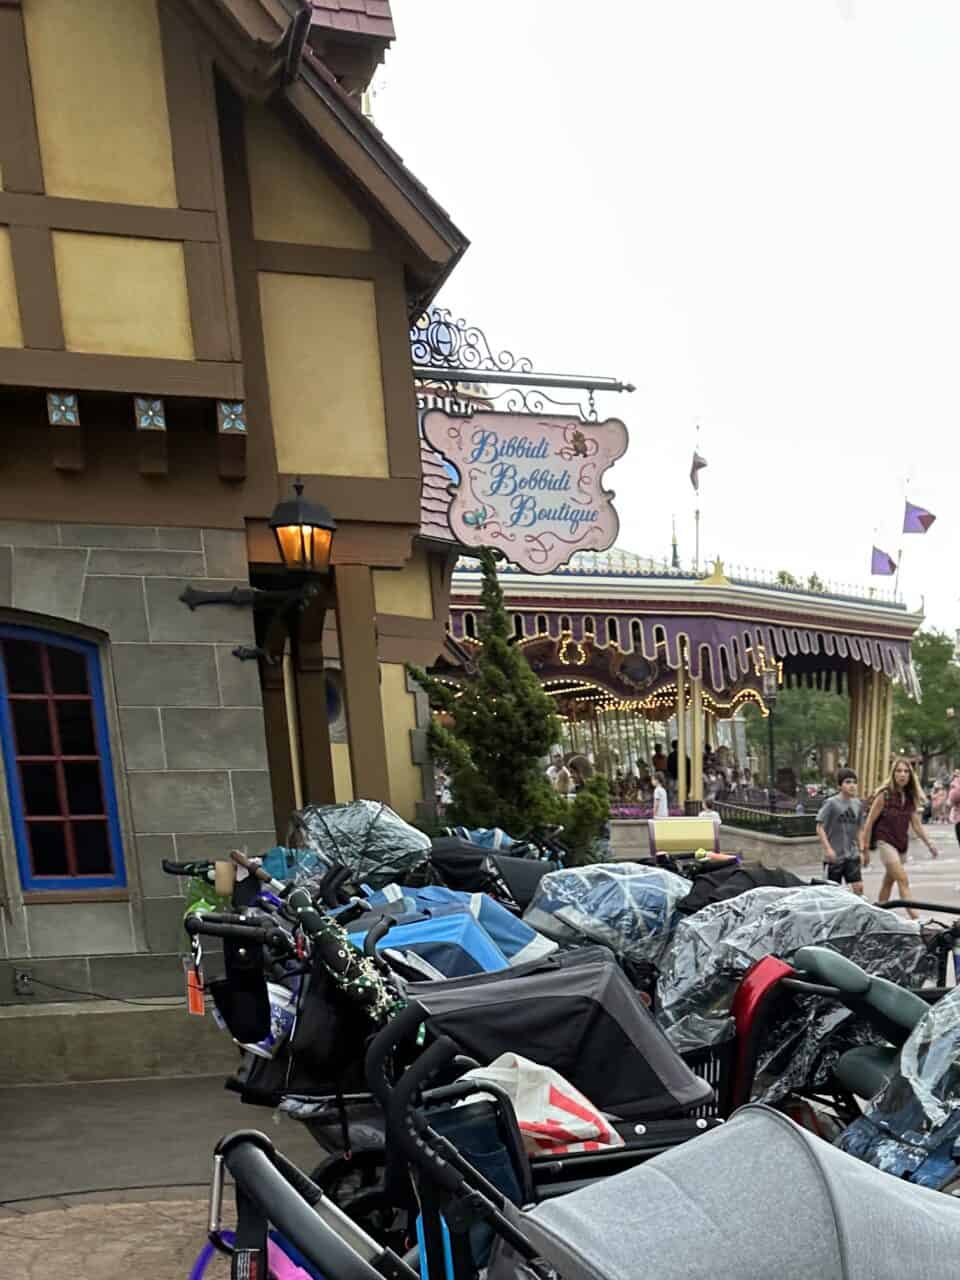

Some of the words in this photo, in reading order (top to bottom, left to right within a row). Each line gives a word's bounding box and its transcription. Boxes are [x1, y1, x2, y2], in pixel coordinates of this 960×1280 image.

[464, 430, 549, 464] Bibbidi
[486, 462, 570, 496] Bobbidi
[503, 495, 599, 534] Boutique
